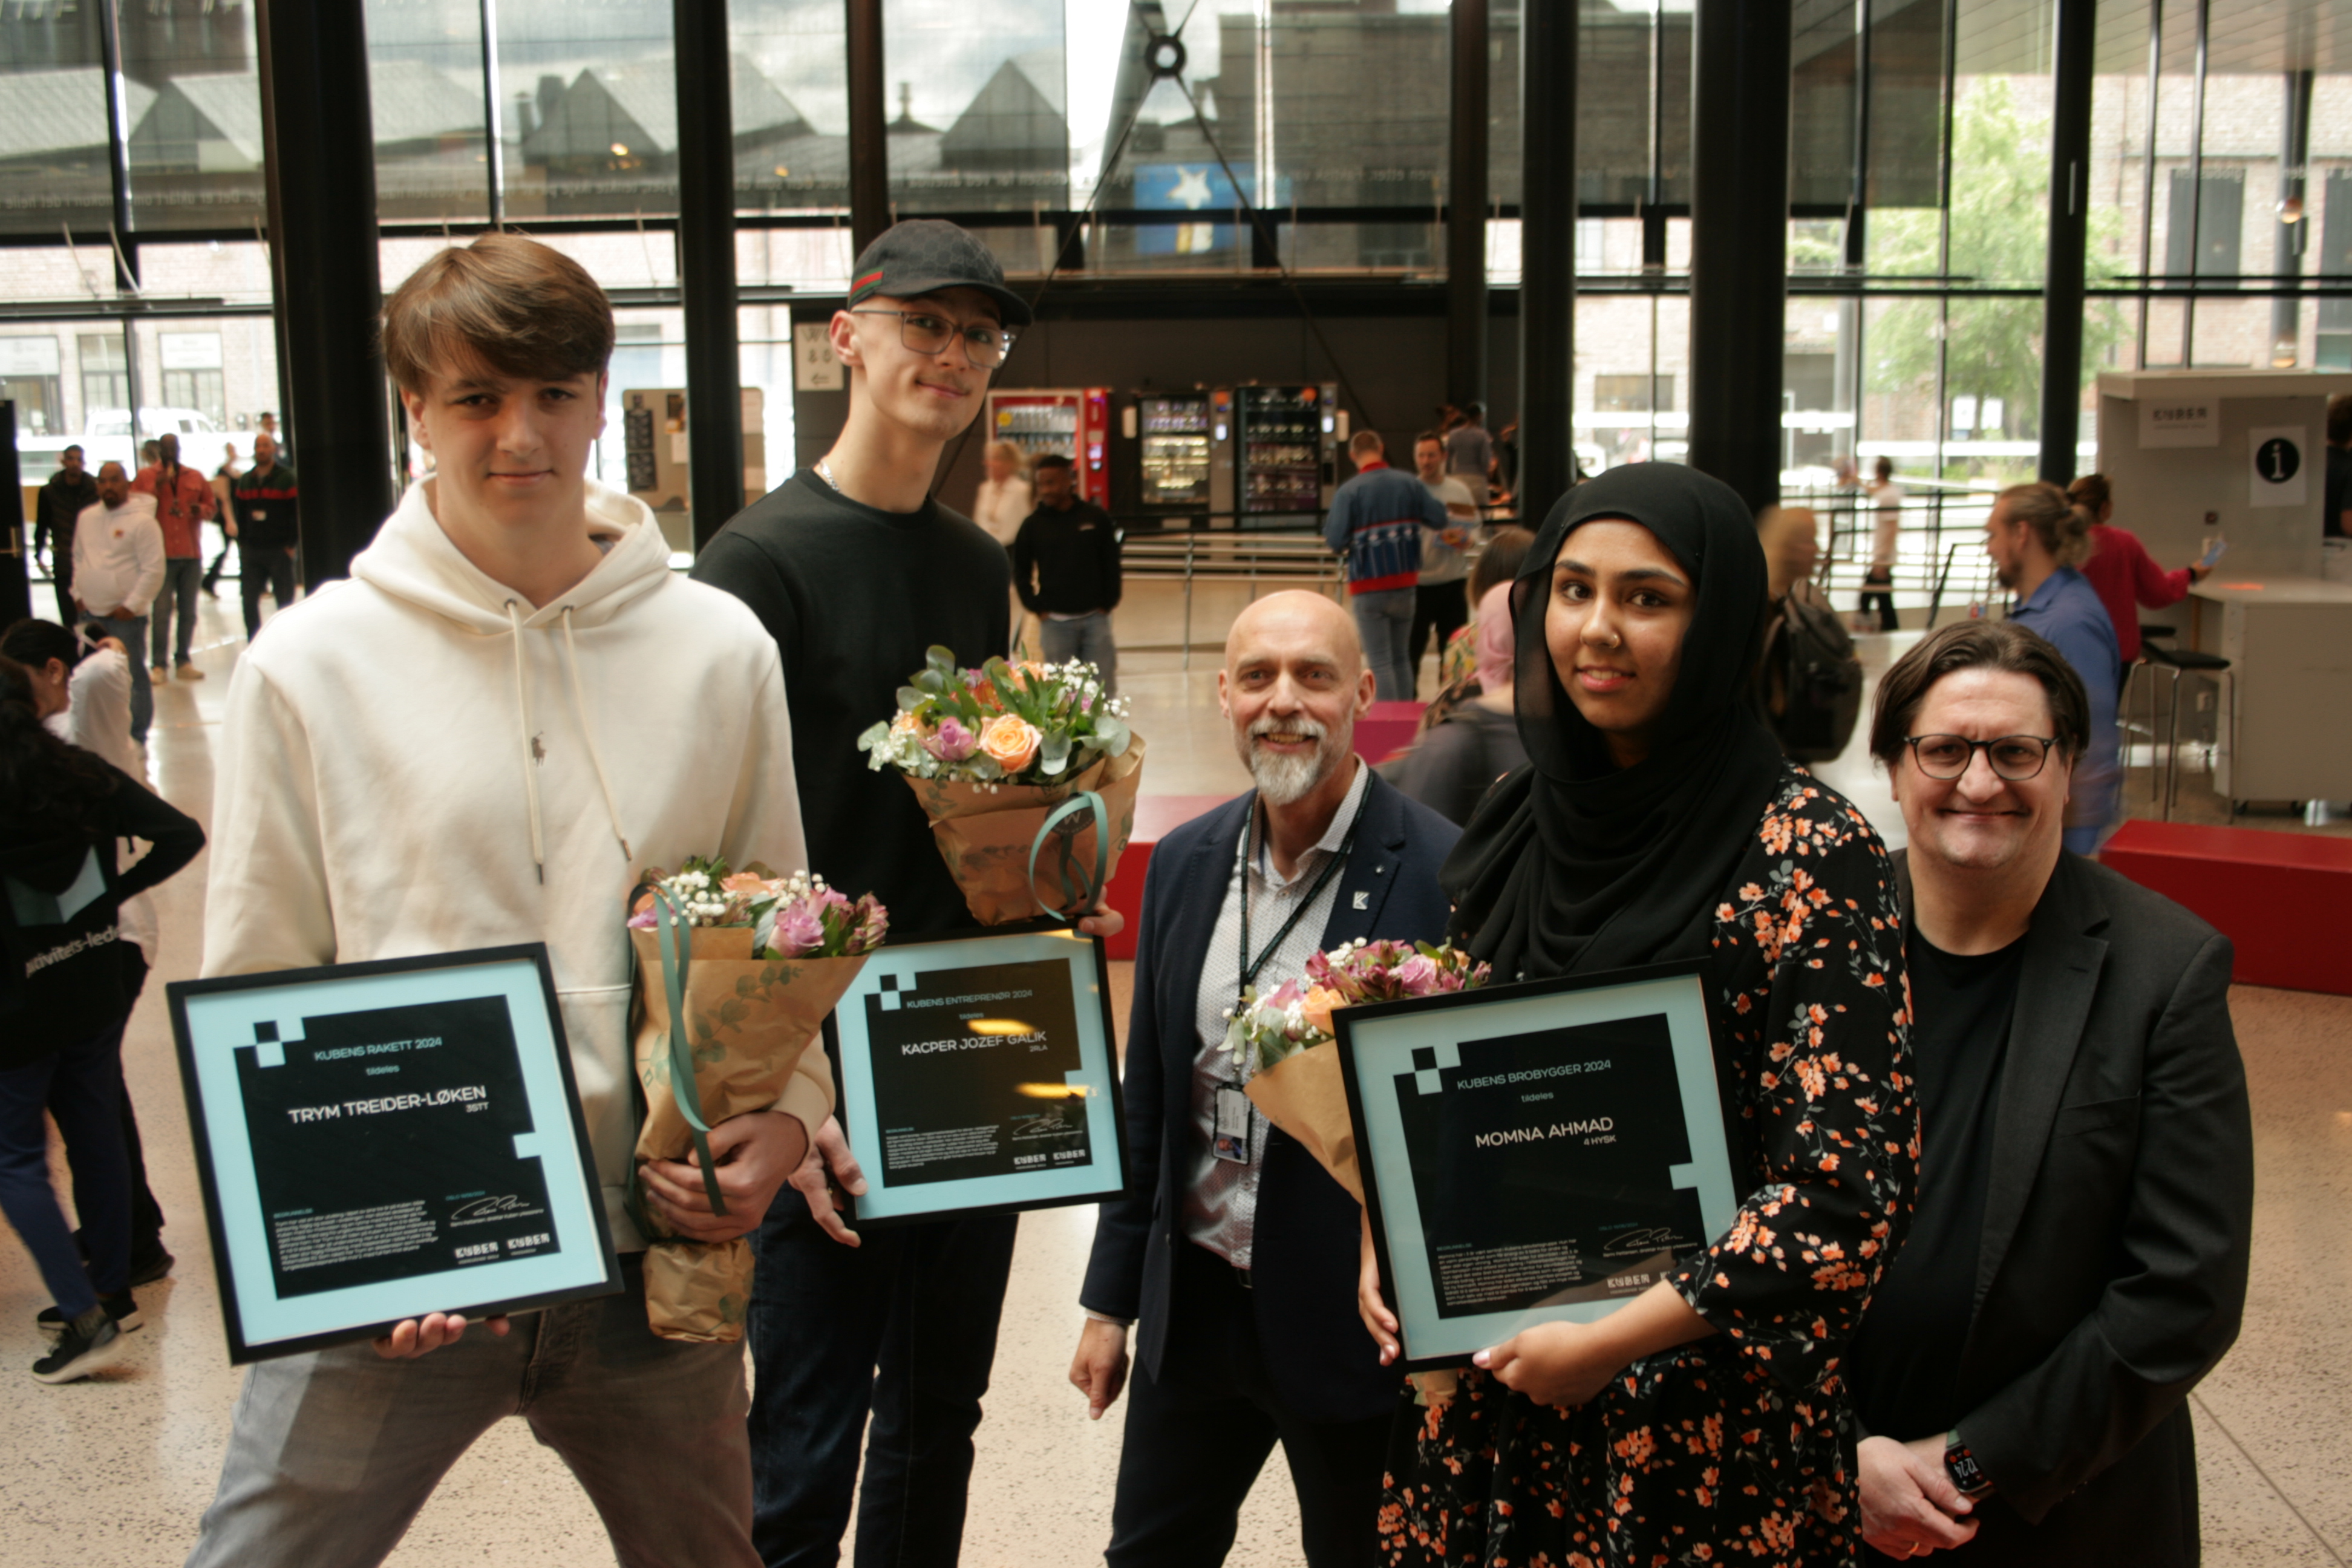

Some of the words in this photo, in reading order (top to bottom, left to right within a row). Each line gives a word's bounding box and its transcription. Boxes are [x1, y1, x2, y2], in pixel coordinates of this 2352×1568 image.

[907, 998, 944, 1008] KUBENS
[946, 991, 1011, 1005] ENTREPRENØR
[1012, 990, 1033, 999] 2024
[314, 1046, 365, 1061] KUBENS
[367, 1040, 413, 1054] RAKETT
[415, 1037, 442, 1049] 2024
[901, 1040, 956, 1055] KACPER
[959, 1035, 1004, 1050] JOZEF
[1007, 1031, 1047, 1045] GALIK
[366, 1065, 399, 1076] tildeles
[1457, 1074, 1506, 1089] KUBENS
[1508, 1063, 1581, 1083] BROBYGGER
[1584, 1060, 1611, 1073] 2024
[288, 1105, 341, 1124] TRYM
[344, 1085, 486, 1116] TREIDER-LØKEN
[1521, 1091, 1554, 1103] tildeles
[1475, 1126, 1544, 1148] MOMNA
[1549, 1117, 1613, 1138] AHMAD
[1591, 1135, 1616, 1145] HYSK
[1607, 1273, 1650, 1288] KUBEN
[1954, 1457, 1979, 1478] 12:24
